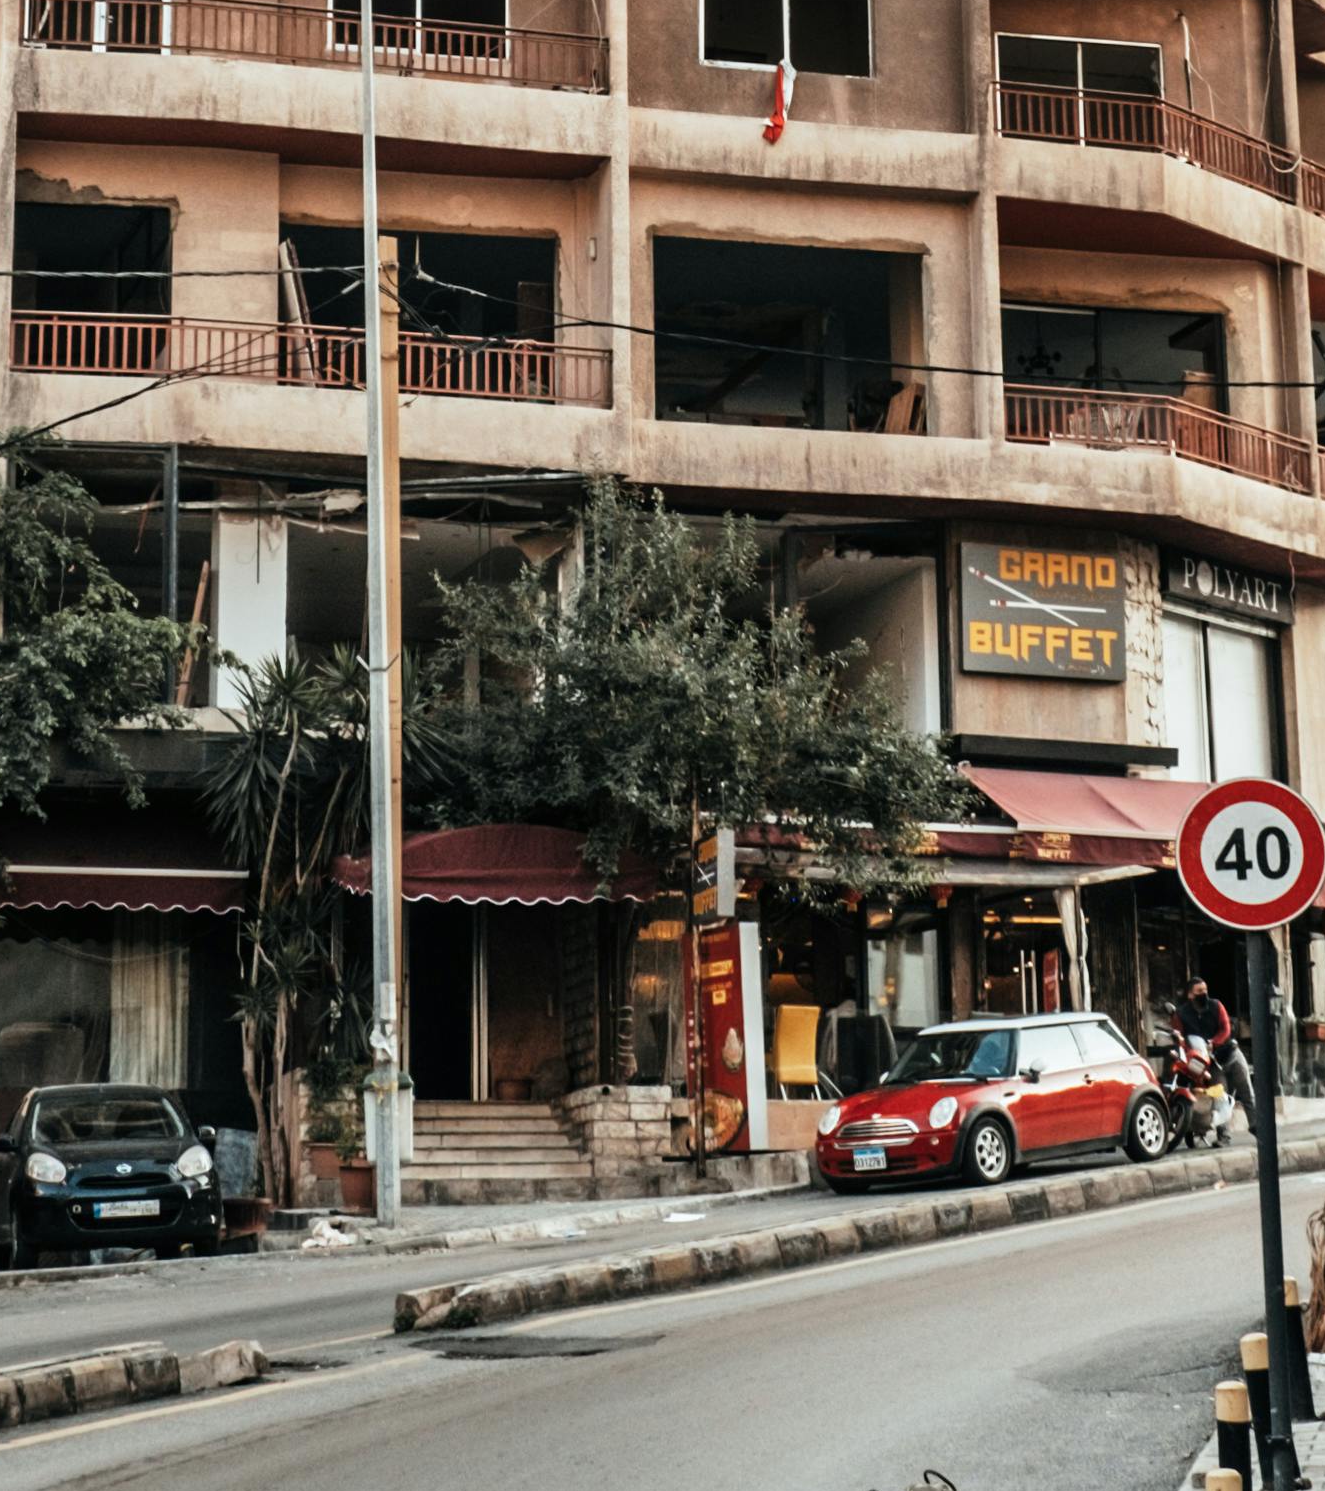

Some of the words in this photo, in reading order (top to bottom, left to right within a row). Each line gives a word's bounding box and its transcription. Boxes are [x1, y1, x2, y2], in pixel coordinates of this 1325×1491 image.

[999, 549, 1116, 591] GRAND
[1182, 557, 1283, 614] POLYART
[968, 620, 1119, 668] BUFFET
[1215, 825, 1291, 881] 40
